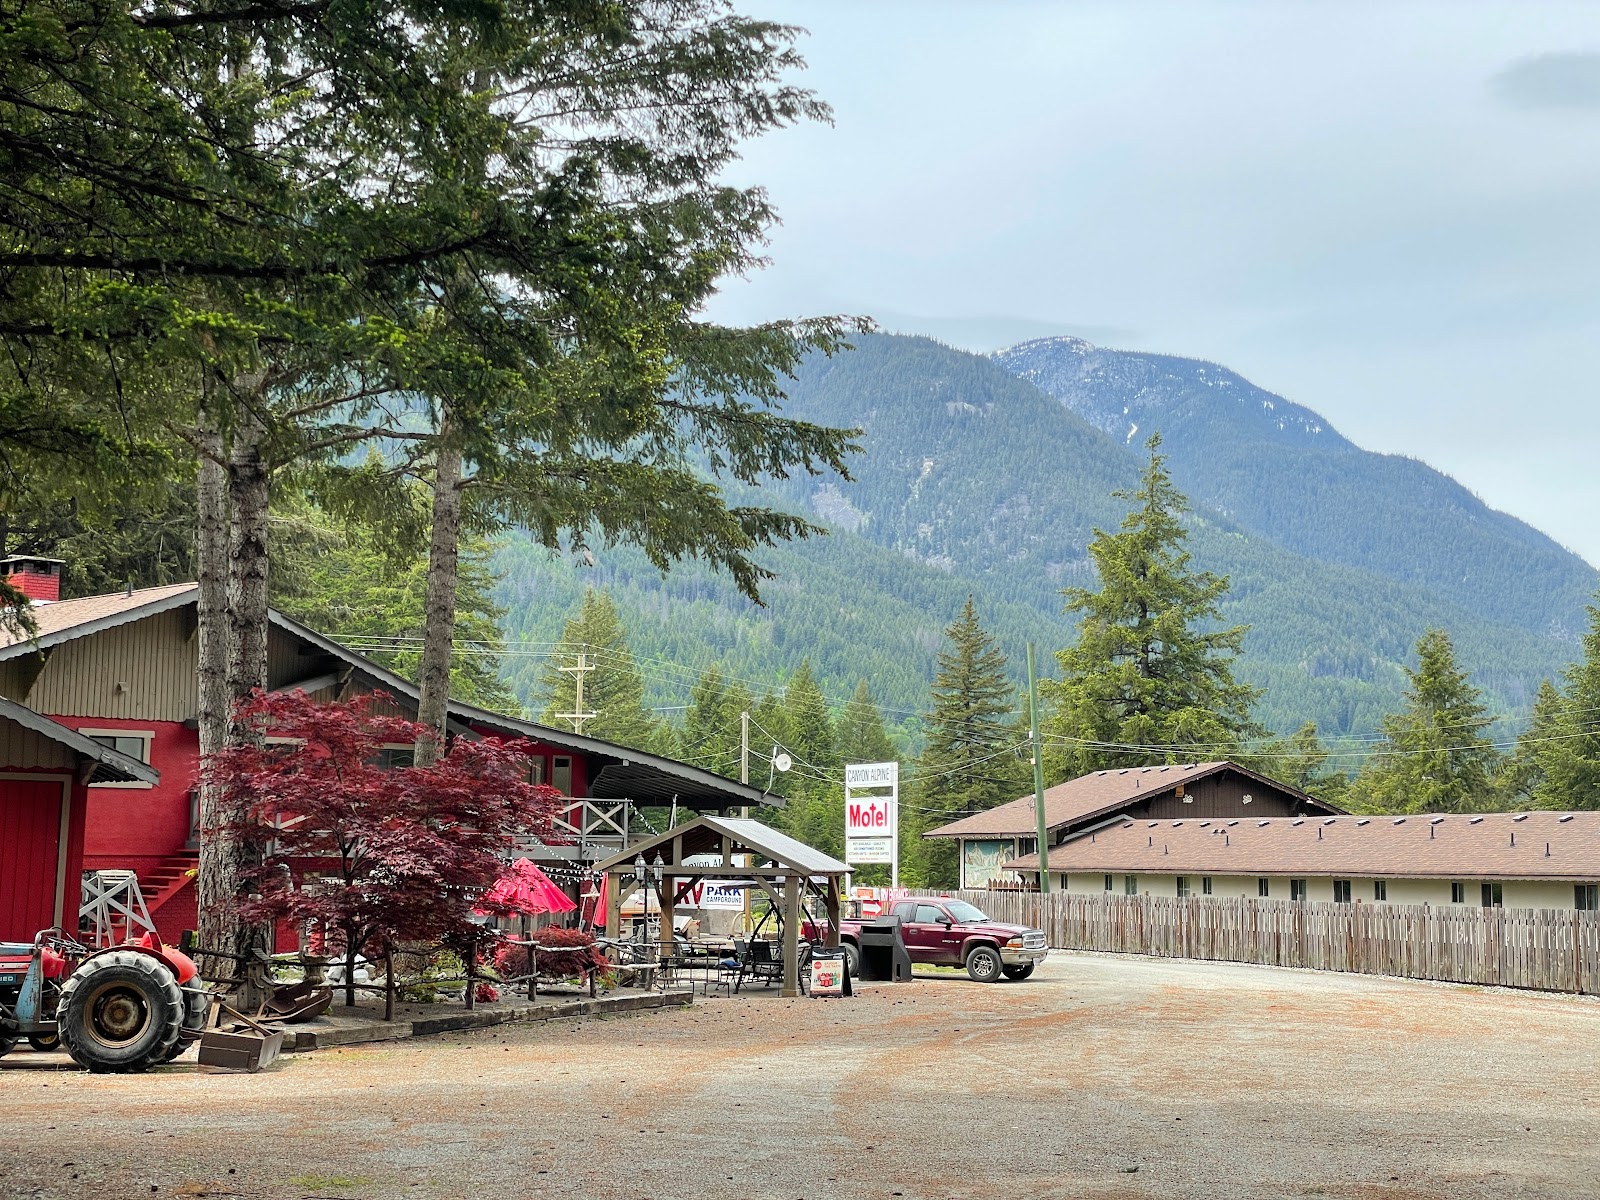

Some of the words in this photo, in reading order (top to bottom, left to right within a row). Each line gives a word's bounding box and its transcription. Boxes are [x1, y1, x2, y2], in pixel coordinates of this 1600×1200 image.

[848, 769, 869, 782] CANYON
[870, 767, 889, 781] ALPINE
[849, 802, 888, 827] Motel
[677, 882, 704, 904] RV
[706, 886, 742, 897] PARK
[706, 896, 742, 904] CAMPGROUND
